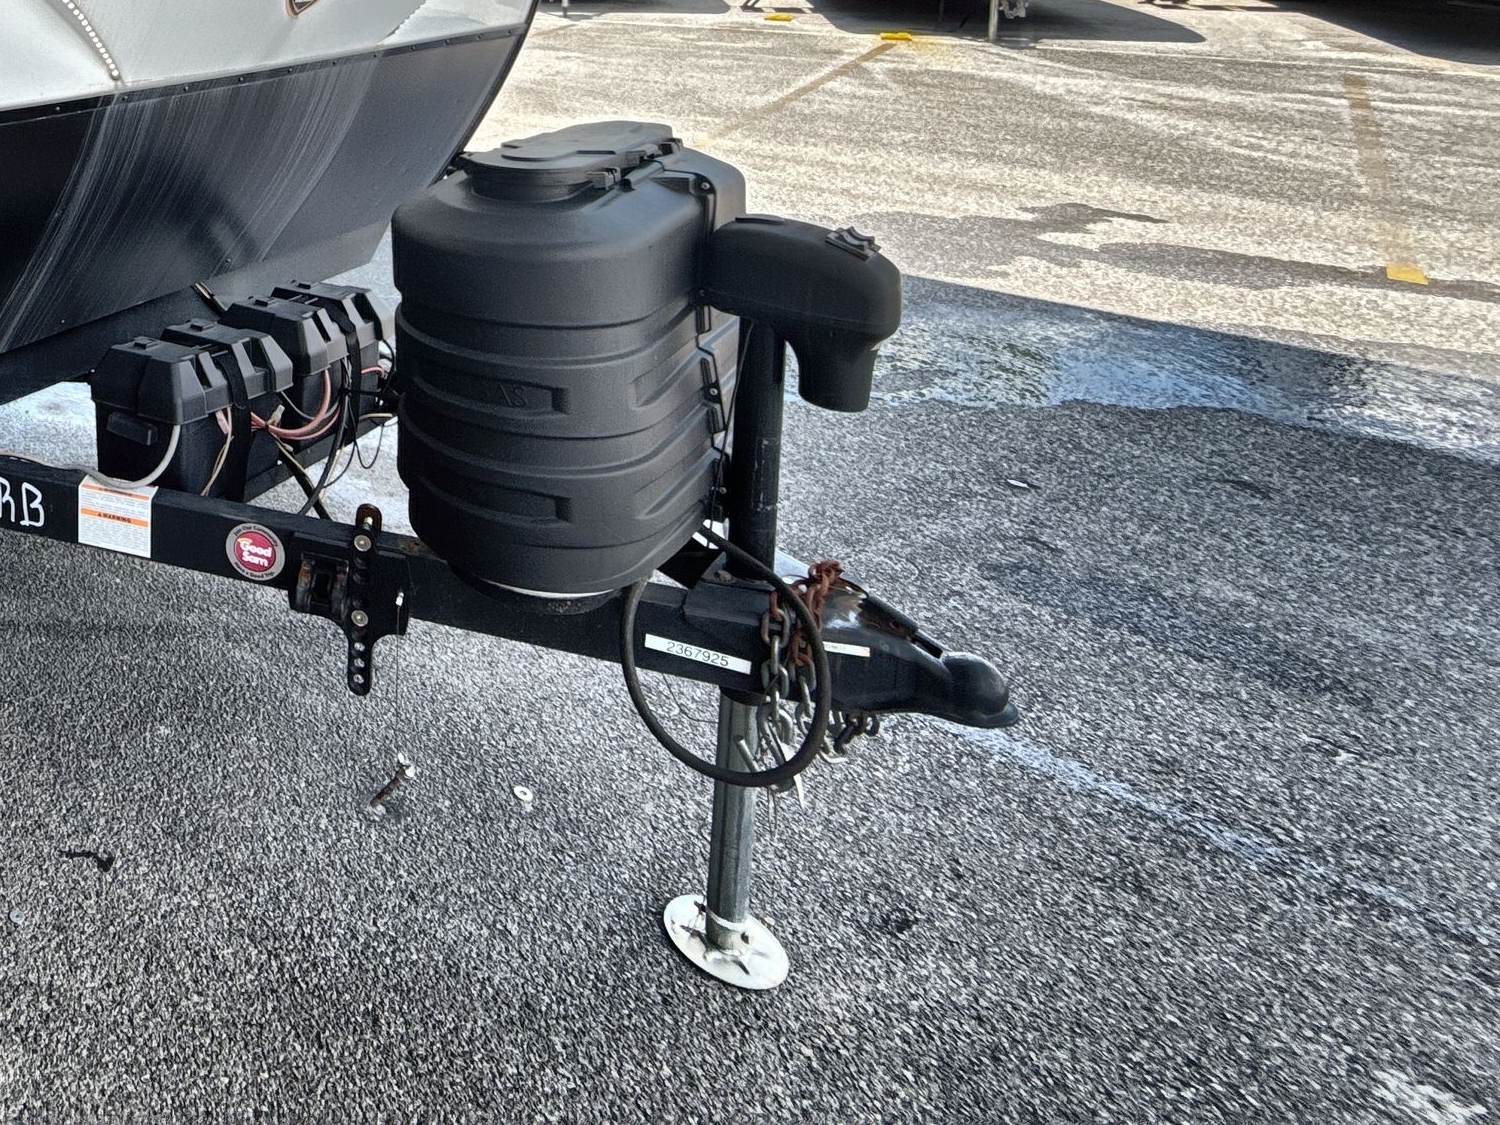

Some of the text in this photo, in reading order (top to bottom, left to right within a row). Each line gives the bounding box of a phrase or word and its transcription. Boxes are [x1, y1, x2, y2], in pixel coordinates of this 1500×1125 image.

[240, 541, 273, 558] Good
[241, 551, 269, 567] Sam
[665, 641, 730, 667] 2367925
